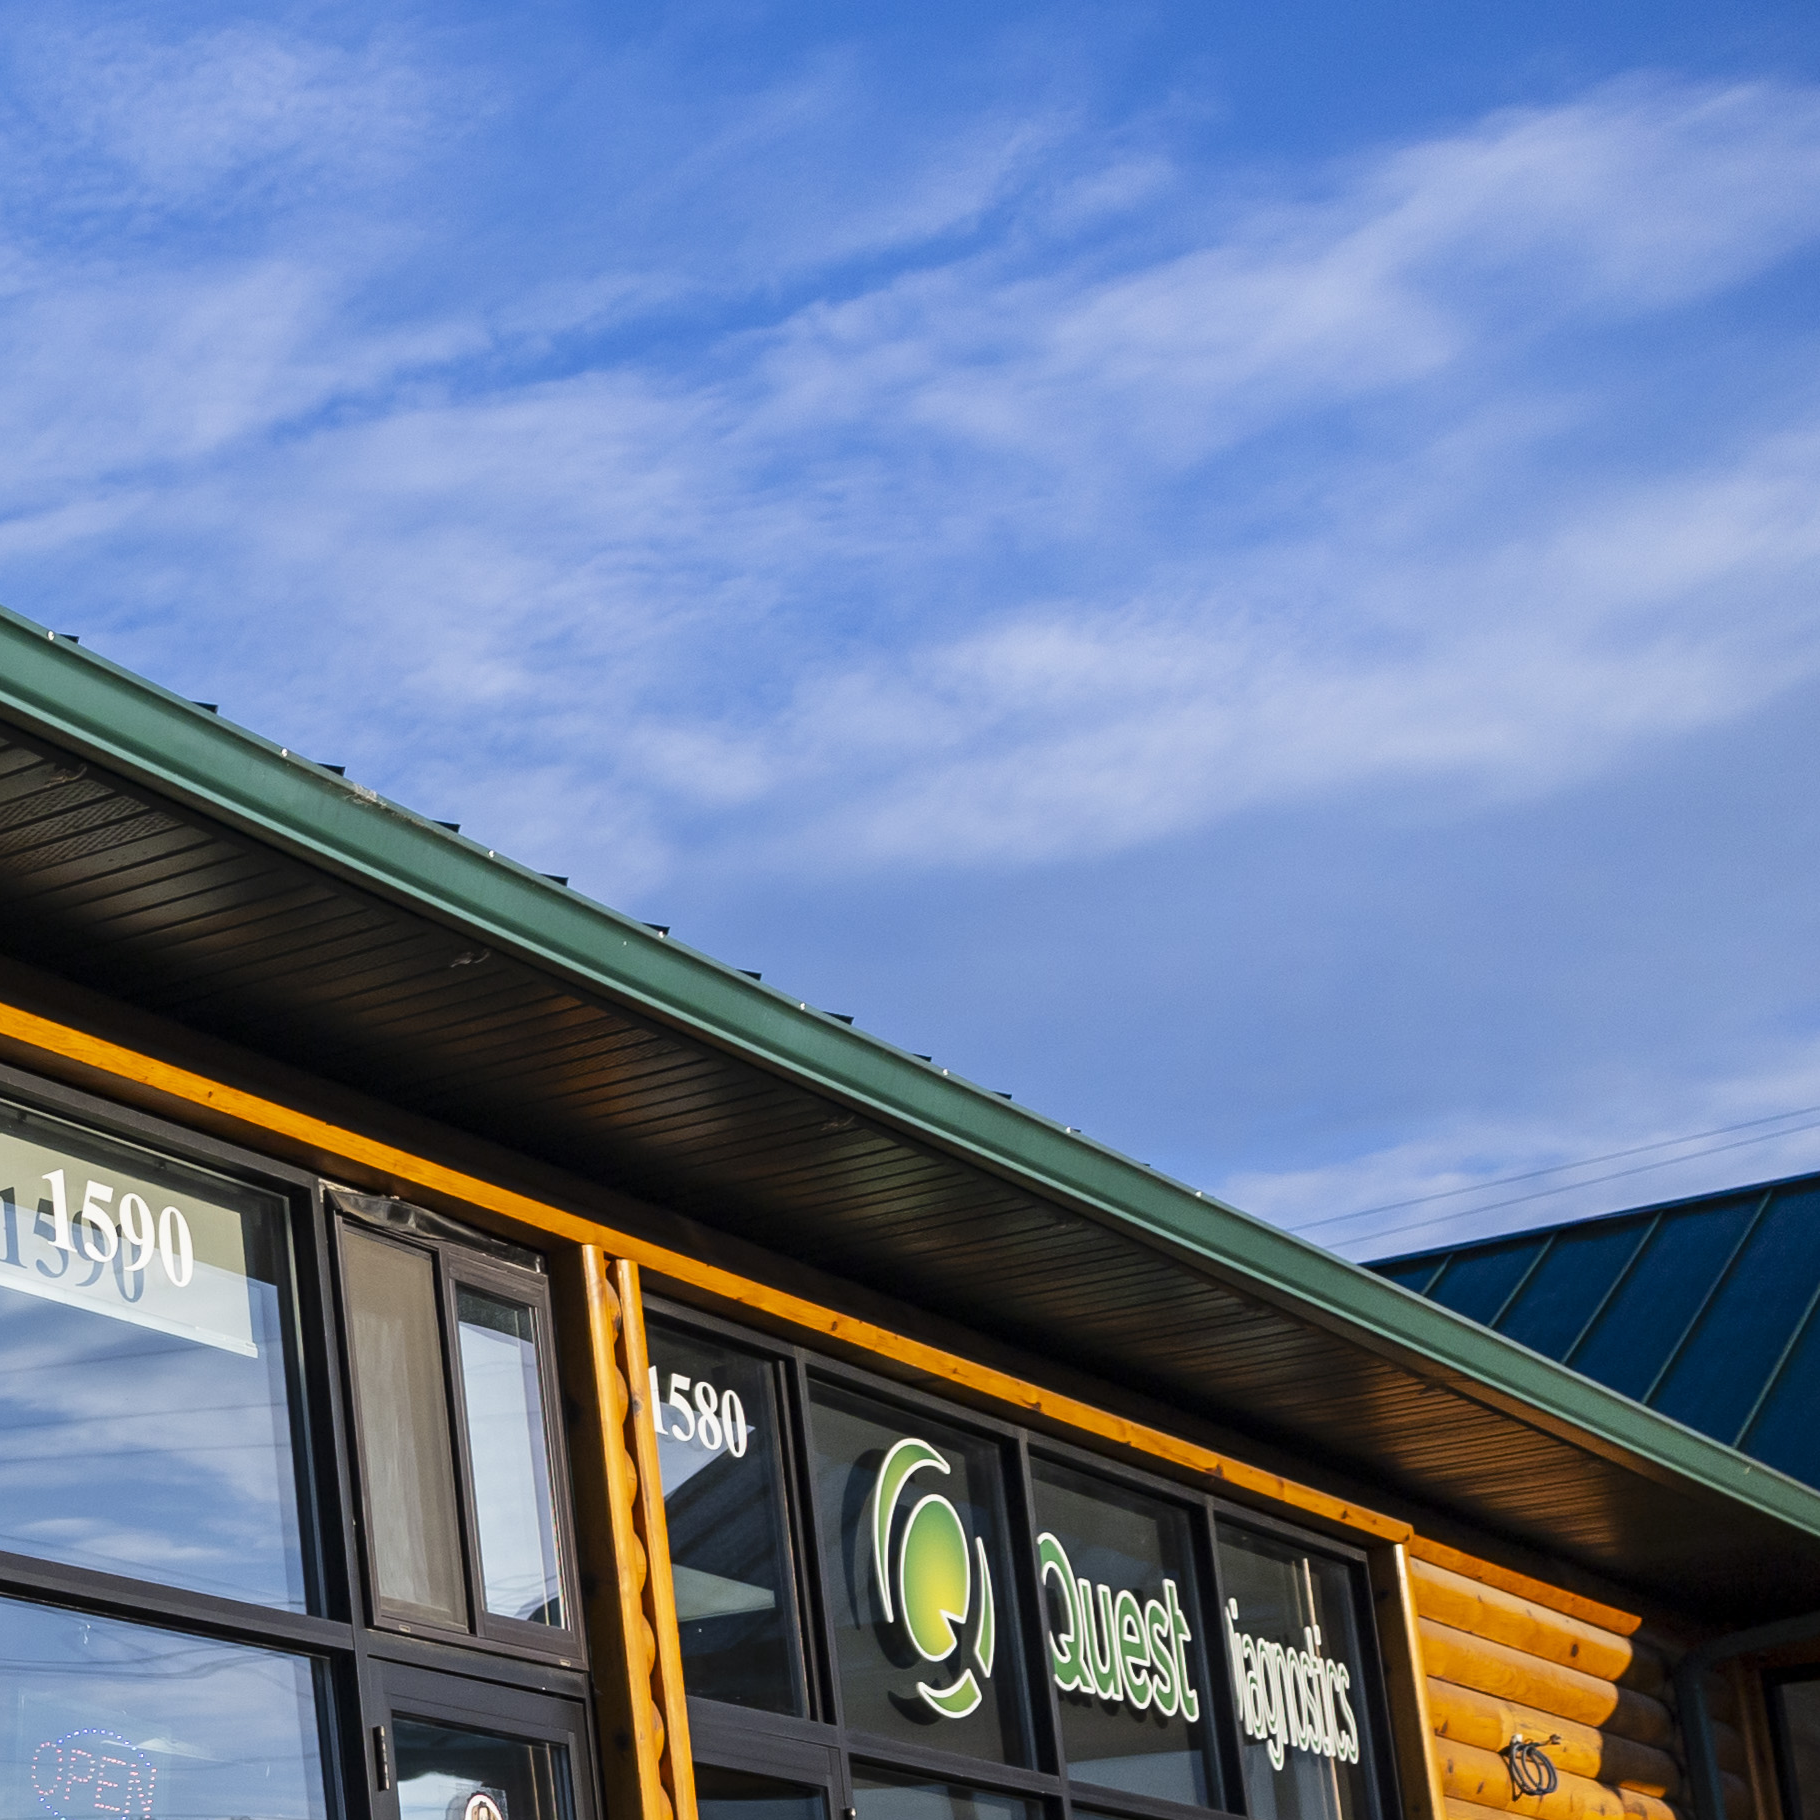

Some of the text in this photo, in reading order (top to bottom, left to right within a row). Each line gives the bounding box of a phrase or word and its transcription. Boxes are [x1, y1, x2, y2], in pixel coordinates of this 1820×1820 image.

[42, 1169, 194, 1288] 1590
[648, 1365, 747, 1458] 1580
[1037, 1532, 1358, 1770] Quest iagnostics
[31, 1741, 157, 1819] OPEN
